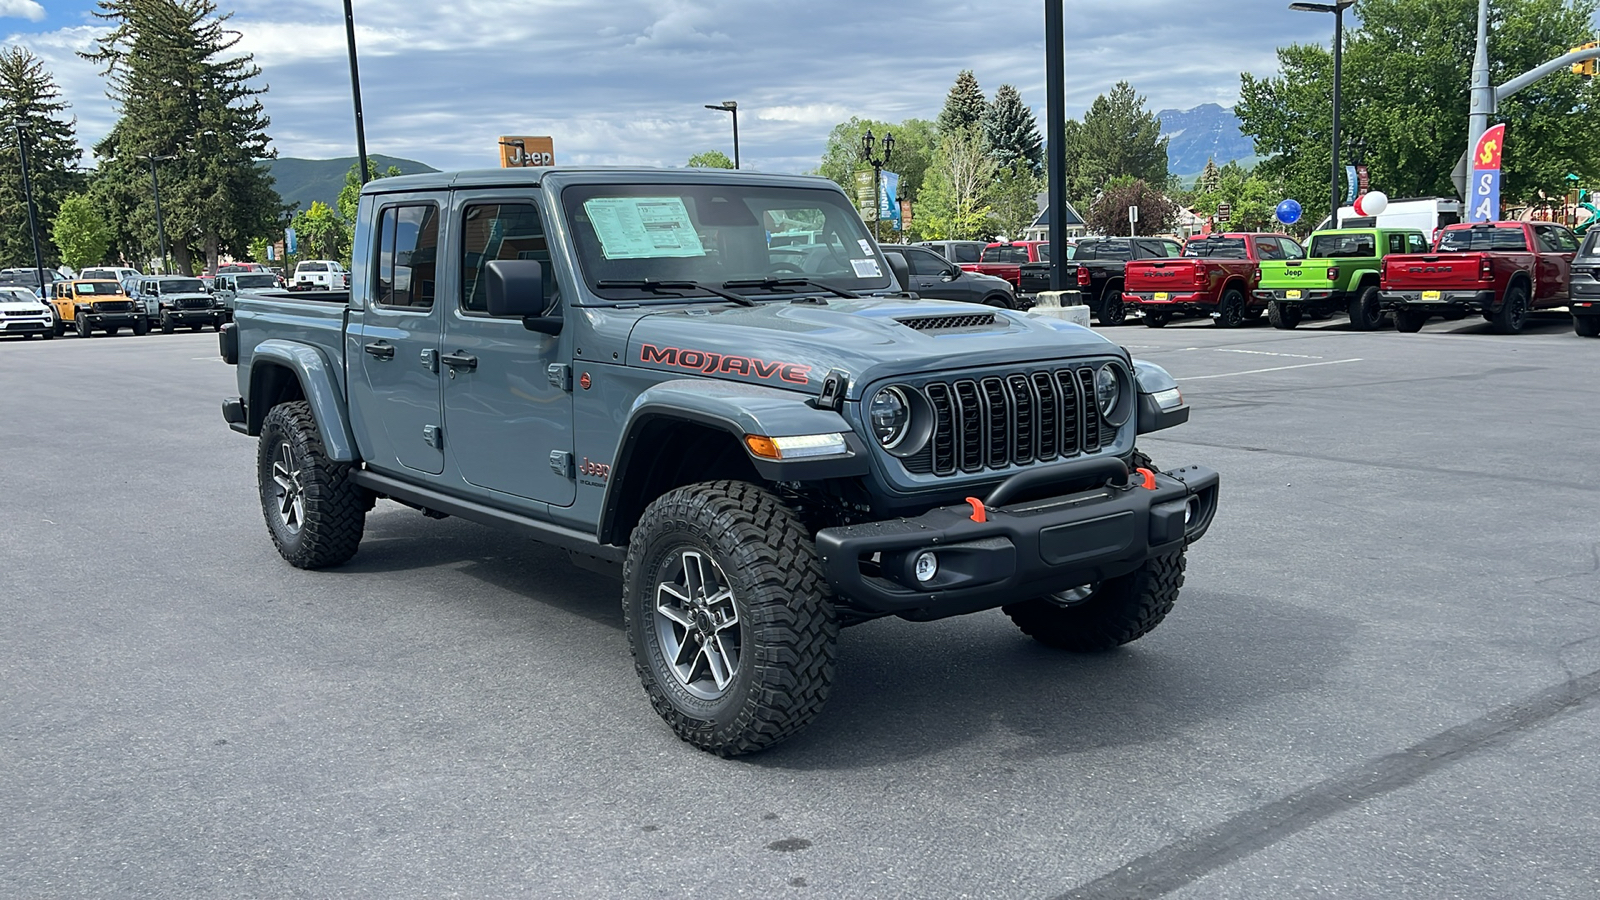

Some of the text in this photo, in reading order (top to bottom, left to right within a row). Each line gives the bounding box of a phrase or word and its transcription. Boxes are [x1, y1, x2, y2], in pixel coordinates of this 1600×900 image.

[509, 148, 552, 166] Jeep
[1474, 173, 1493, 219] SA
[1284, 269, 1303, 277] Jeep
[641, 344, 812, 384] MOJAVE
[579, 456, 610, 482] Jeep
